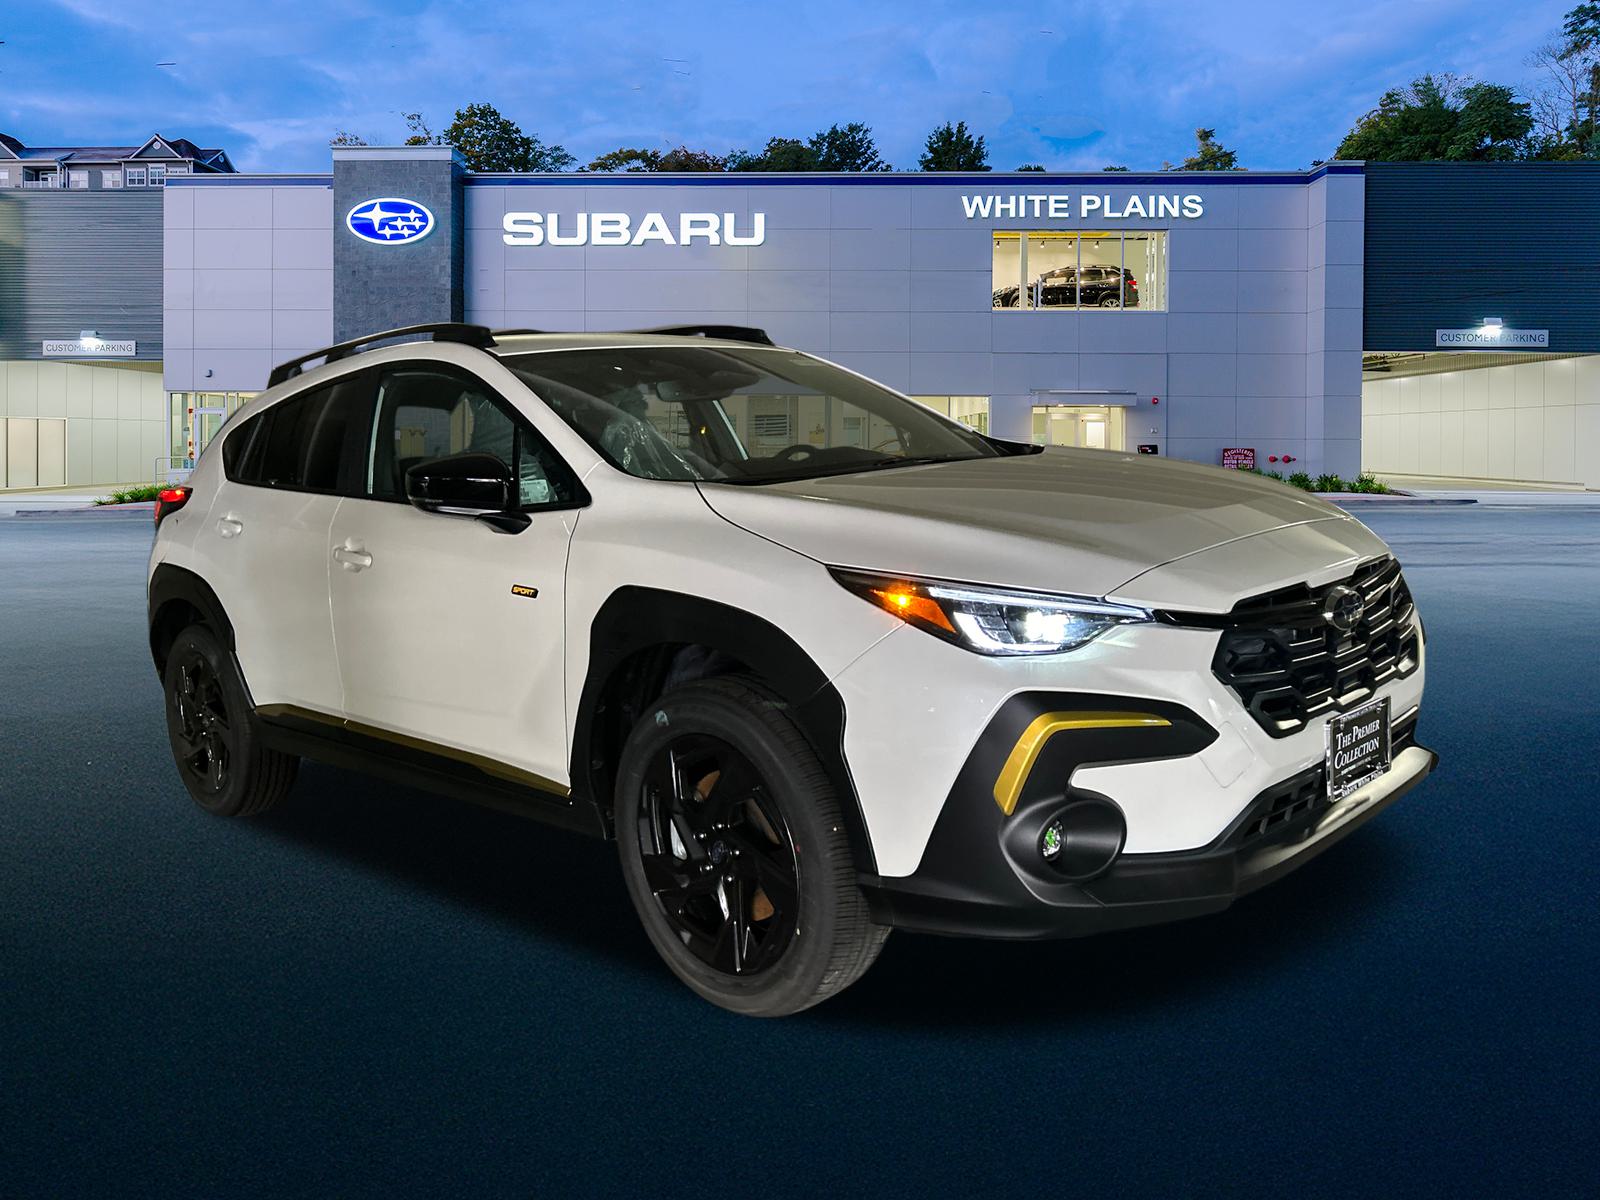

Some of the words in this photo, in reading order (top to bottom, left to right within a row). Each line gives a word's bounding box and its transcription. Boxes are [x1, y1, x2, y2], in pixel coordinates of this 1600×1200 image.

[961, 195, 1069, 218] WHITE
[1080, 194, 1204, 218] PLAINS
[502, 212, 765, 246] SUBARU
[95, 344, 133, 352] PARKING
[1440, 333, 1496, 342] CUSTOMER
[1500, 334, 1545, 343] PARKING
[513, 586, 534, 595] SPORT
[1336, 732, 1352, 751] THE
[1353, 720, 1380, 742] PREMIER
[1334, 737, 1380, 769] COLLECTION
